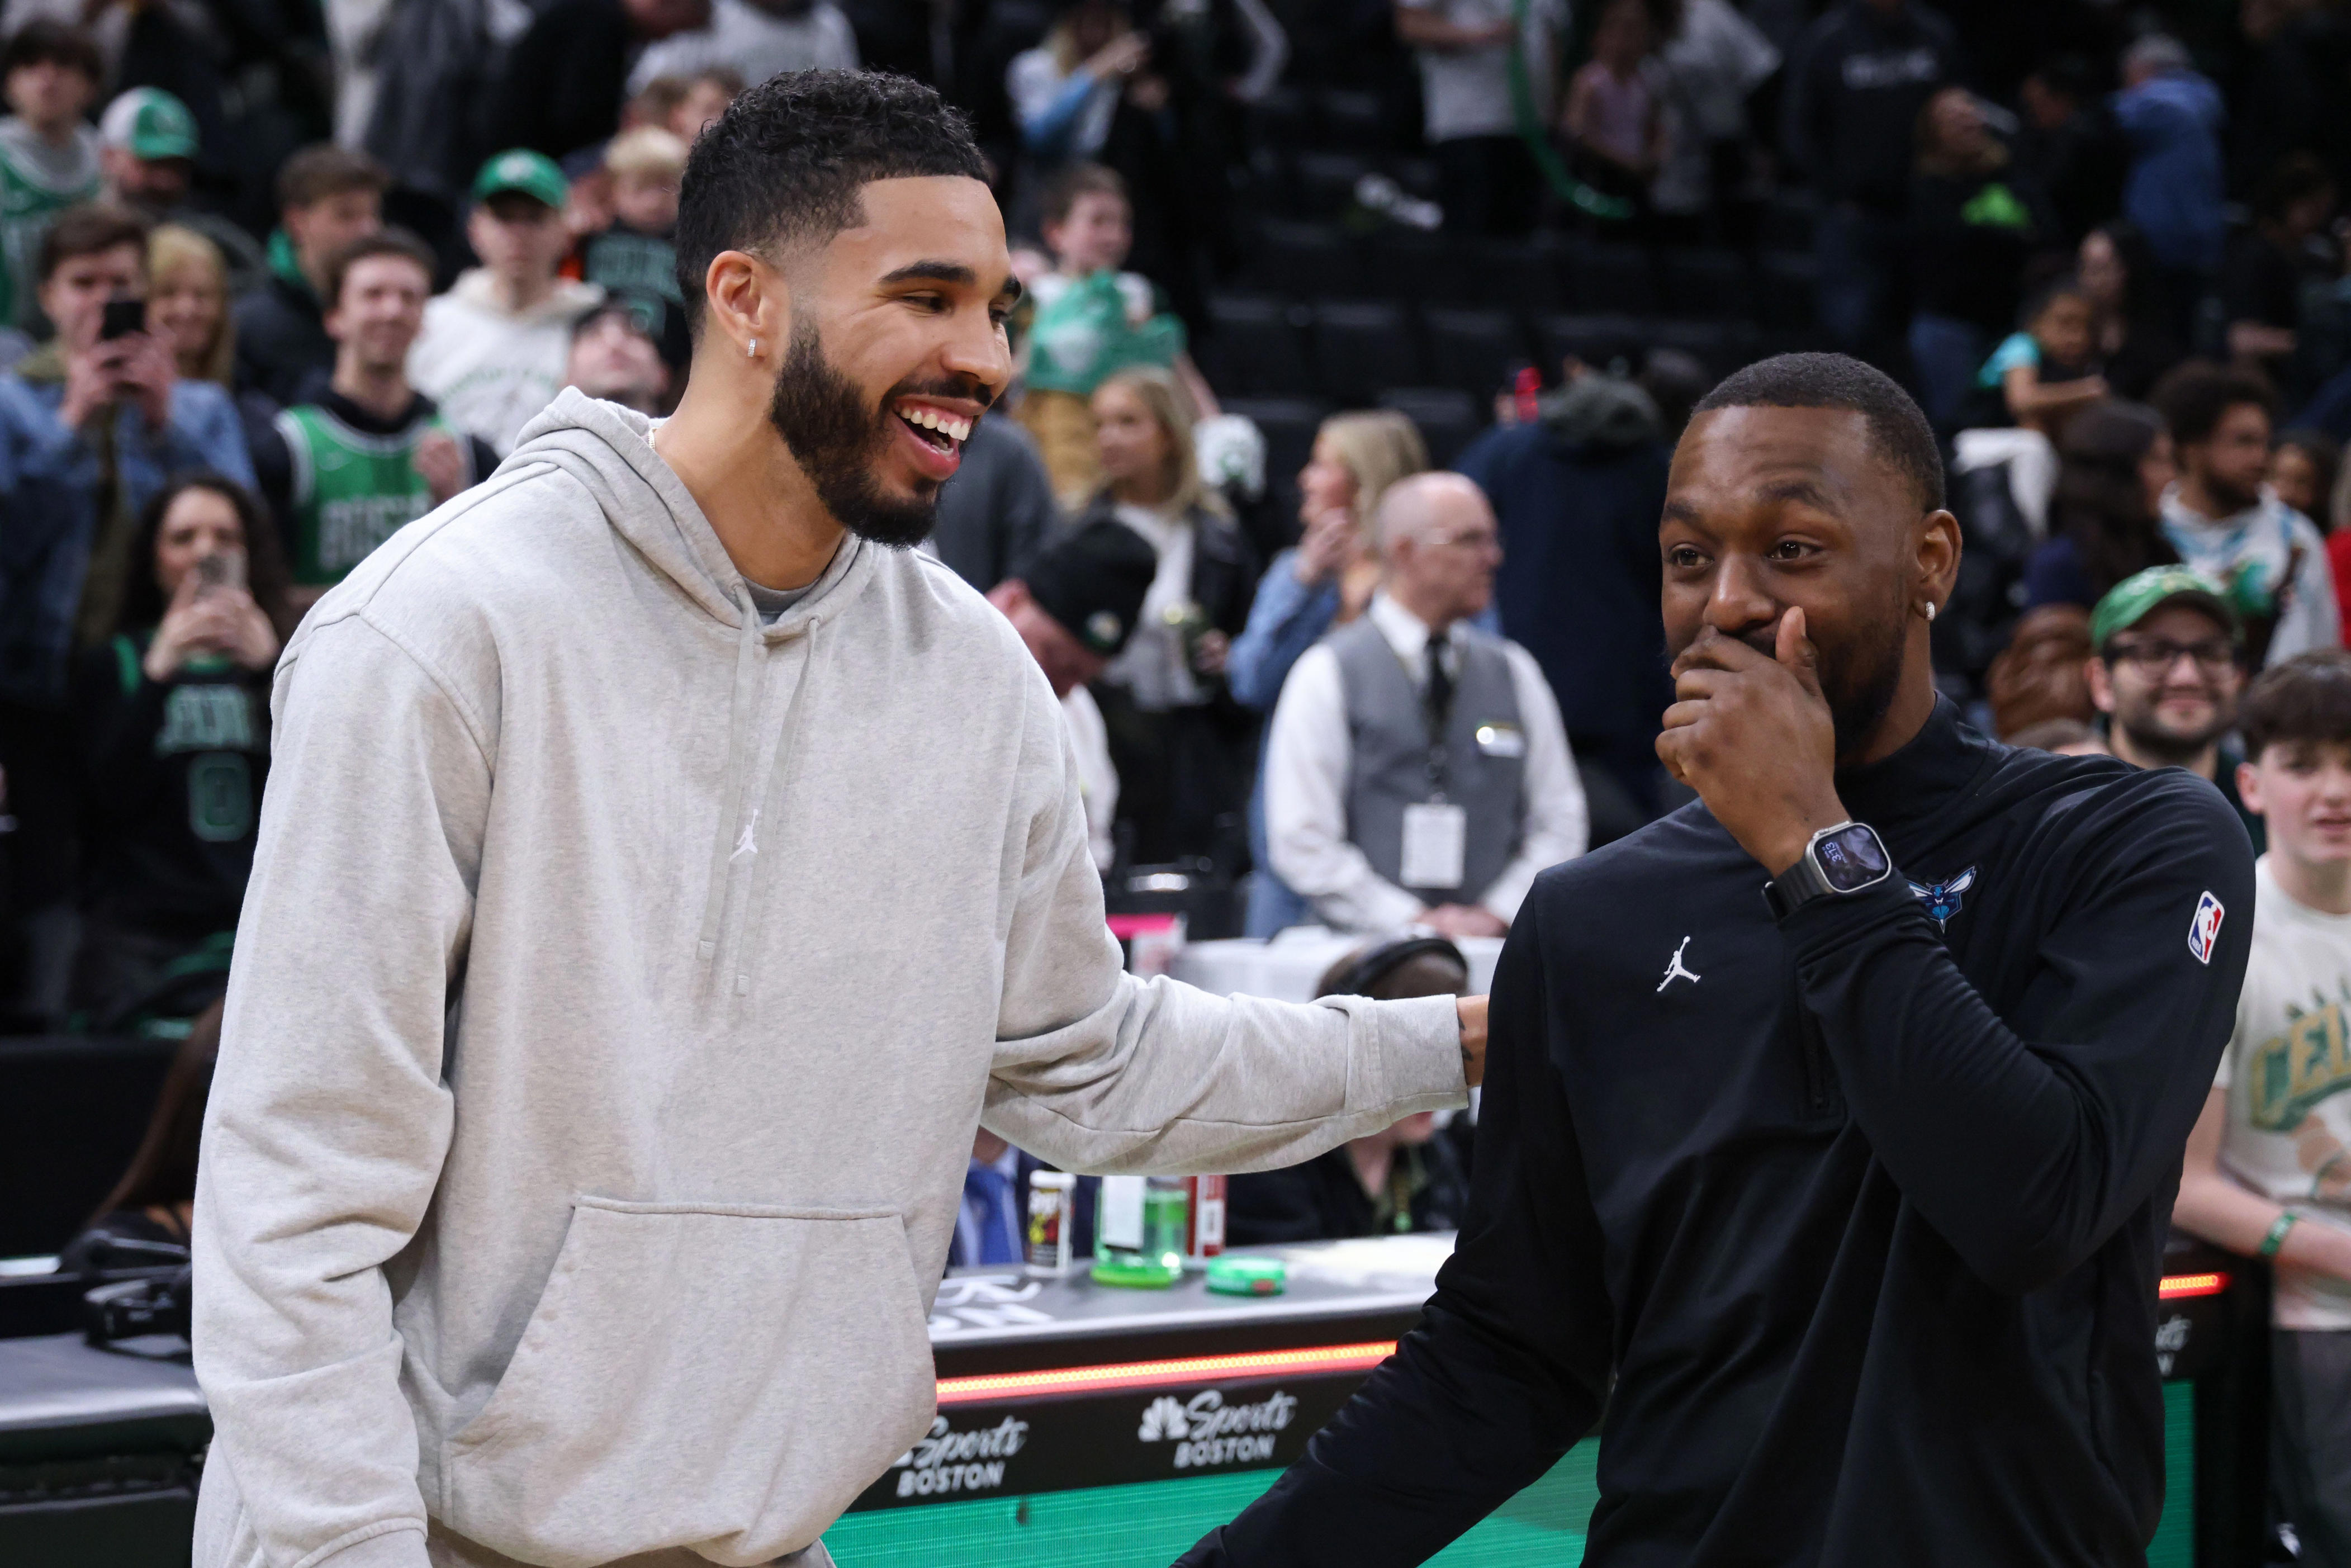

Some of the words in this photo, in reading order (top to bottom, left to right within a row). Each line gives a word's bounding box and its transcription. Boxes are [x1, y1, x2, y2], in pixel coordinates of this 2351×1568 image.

[1825, 842, 1842, 862] 3:13
[2191, 936, 2202, 954] NBA
[1186, 1389, 1297, 1442] Sports
[912, 1415, 1030, 1468] Sports
[1174, 1433, 1277, 1468] BOSTON
[895, 1461, 1005, 1498] BOSTON
